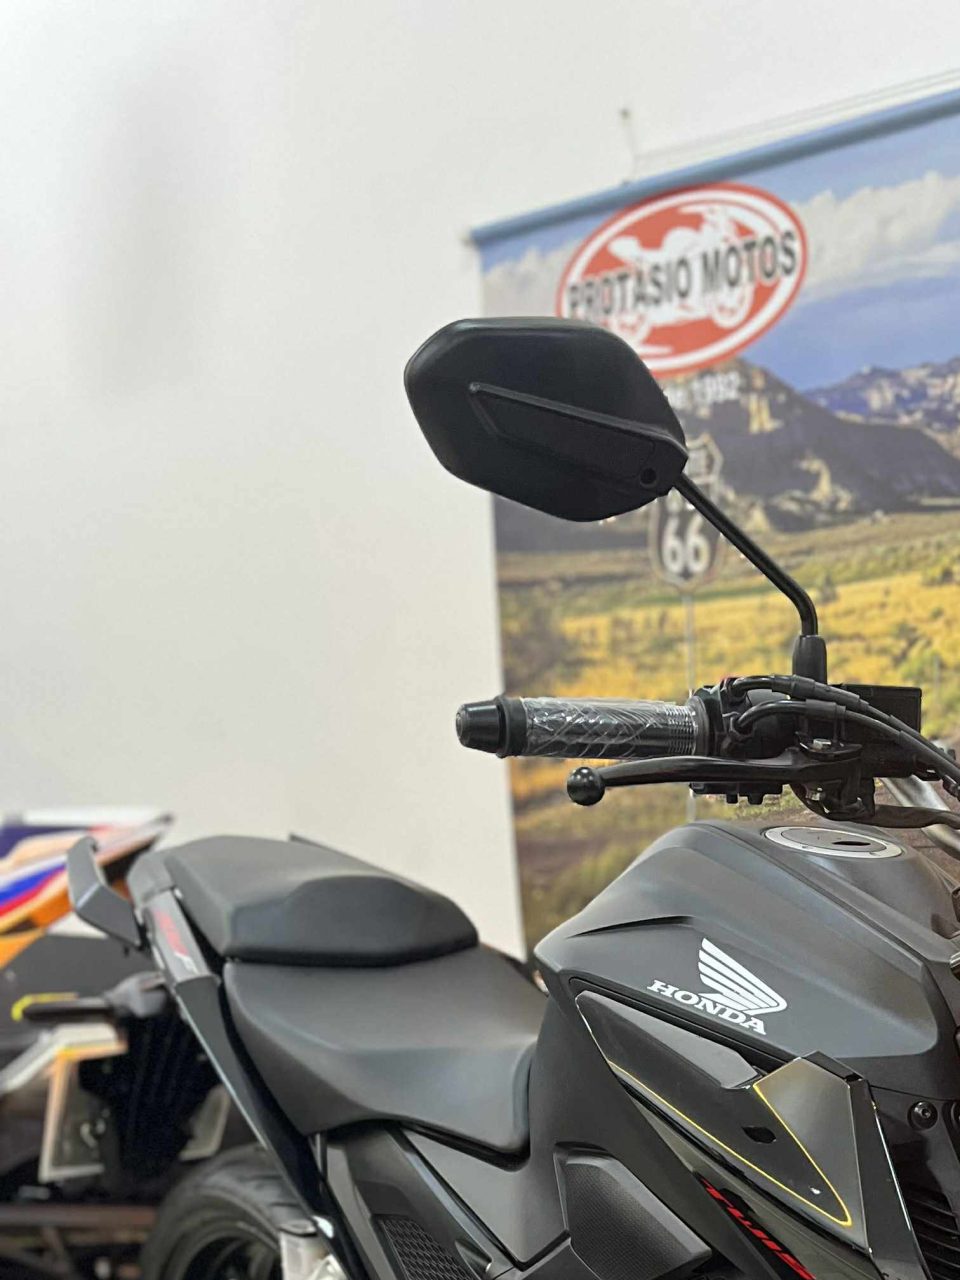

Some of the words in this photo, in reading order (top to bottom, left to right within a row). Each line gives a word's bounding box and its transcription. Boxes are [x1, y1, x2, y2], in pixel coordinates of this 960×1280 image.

[702, 231, 796, 293] MOTOS
[662, 512, 711, 574] 66
[646, 979, 768, 1035] HONDA
